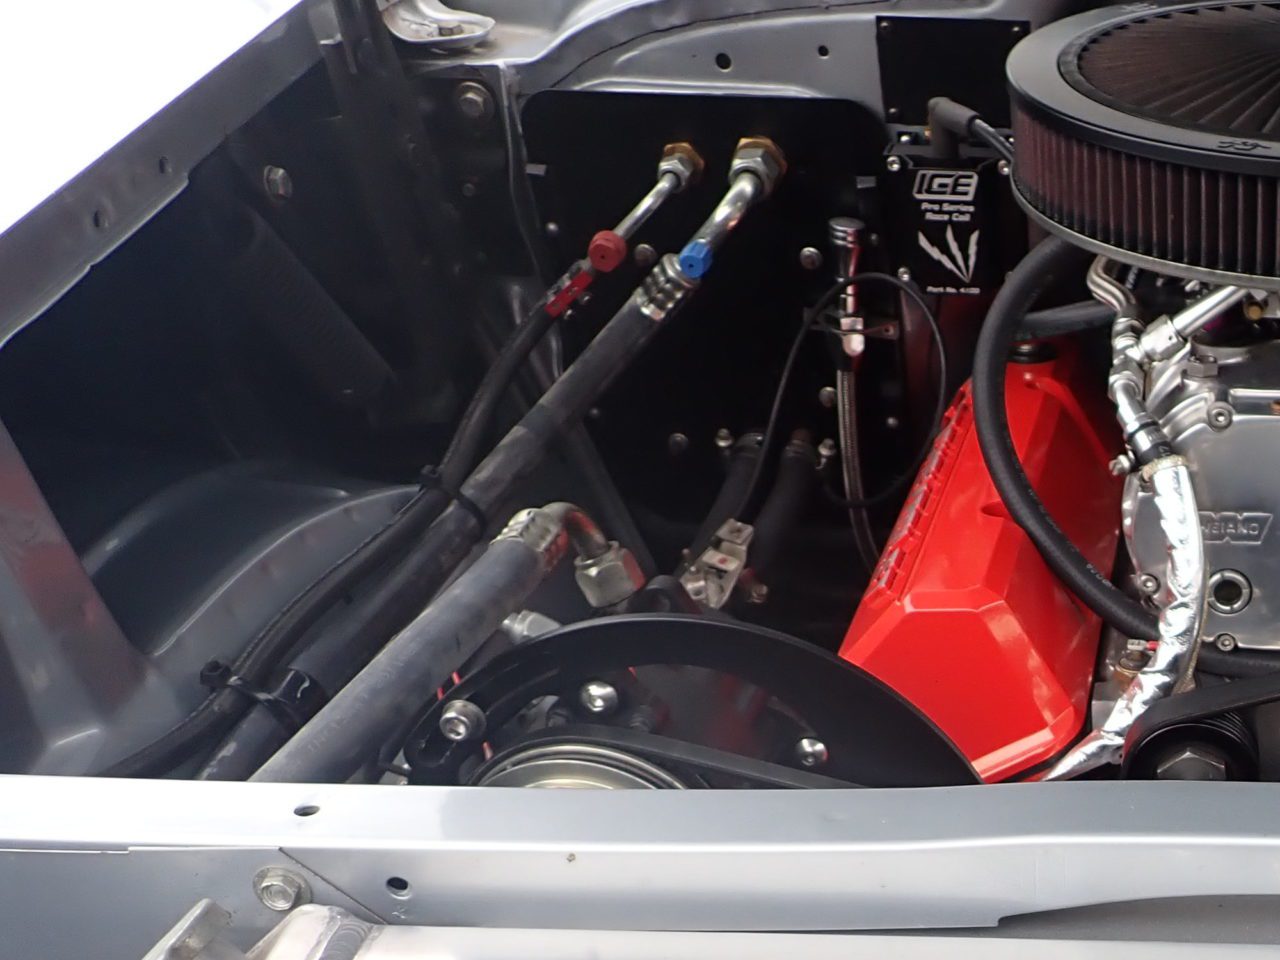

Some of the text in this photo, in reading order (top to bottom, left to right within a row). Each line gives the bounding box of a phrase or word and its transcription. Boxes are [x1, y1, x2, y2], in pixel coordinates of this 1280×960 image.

[914, 172, 976, 198] ICE
[921, 202, 974, 212] Pro Series
[925, 212, 970, 221] Race Coil
